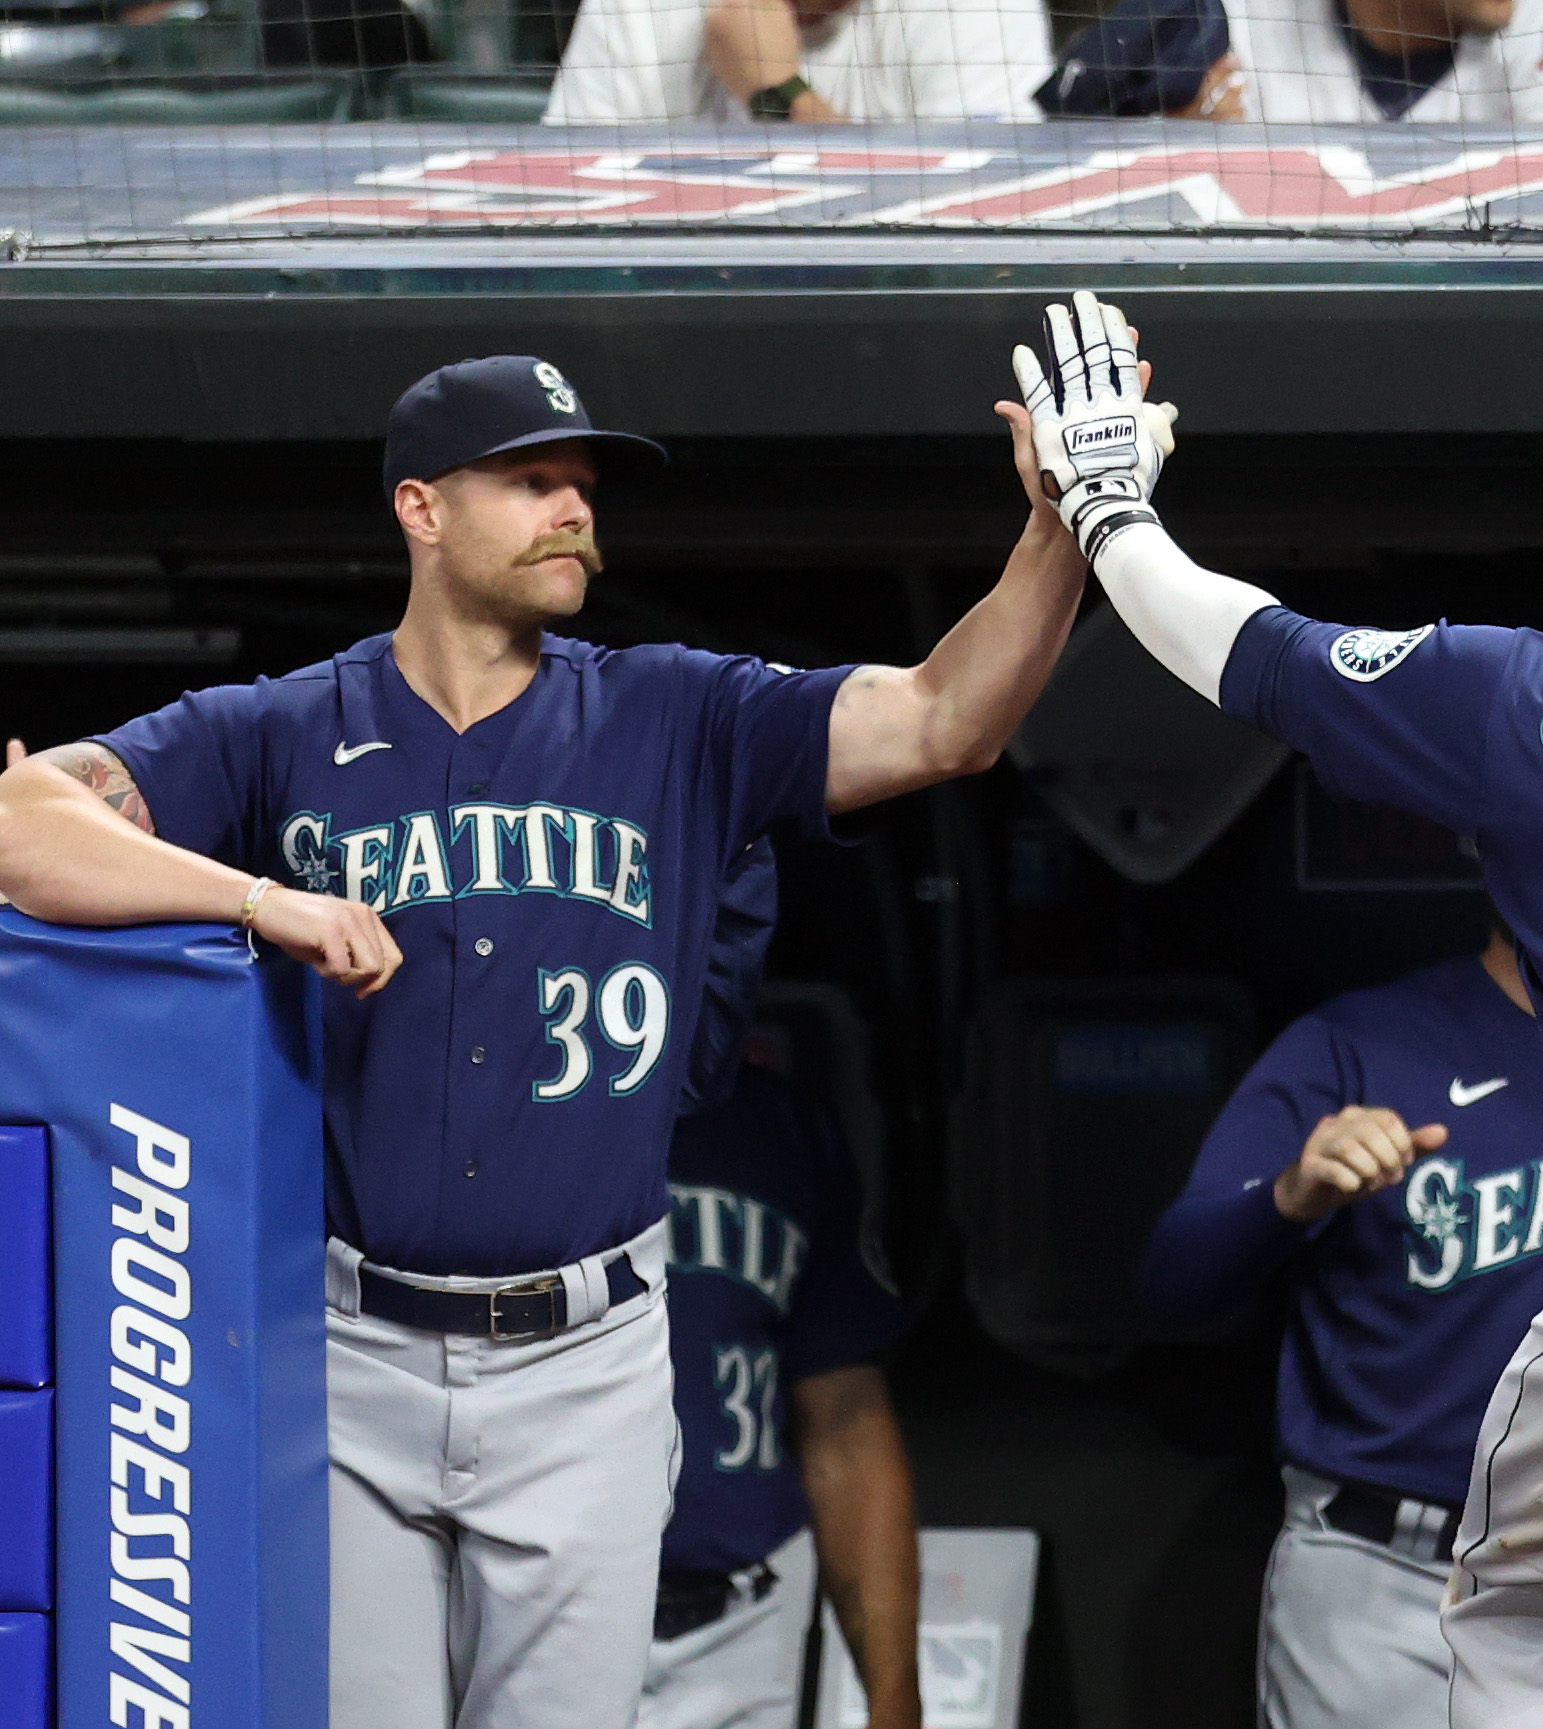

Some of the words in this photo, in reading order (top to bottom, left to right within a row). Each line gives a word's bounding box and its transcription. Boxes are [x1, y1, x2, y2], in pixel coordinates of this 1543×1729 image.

[280, 801, 652, 929] SEATTLE
[533, 960, 670, 1102] 39
[109, 1101, 191, 1729] PROGRESSIVE
